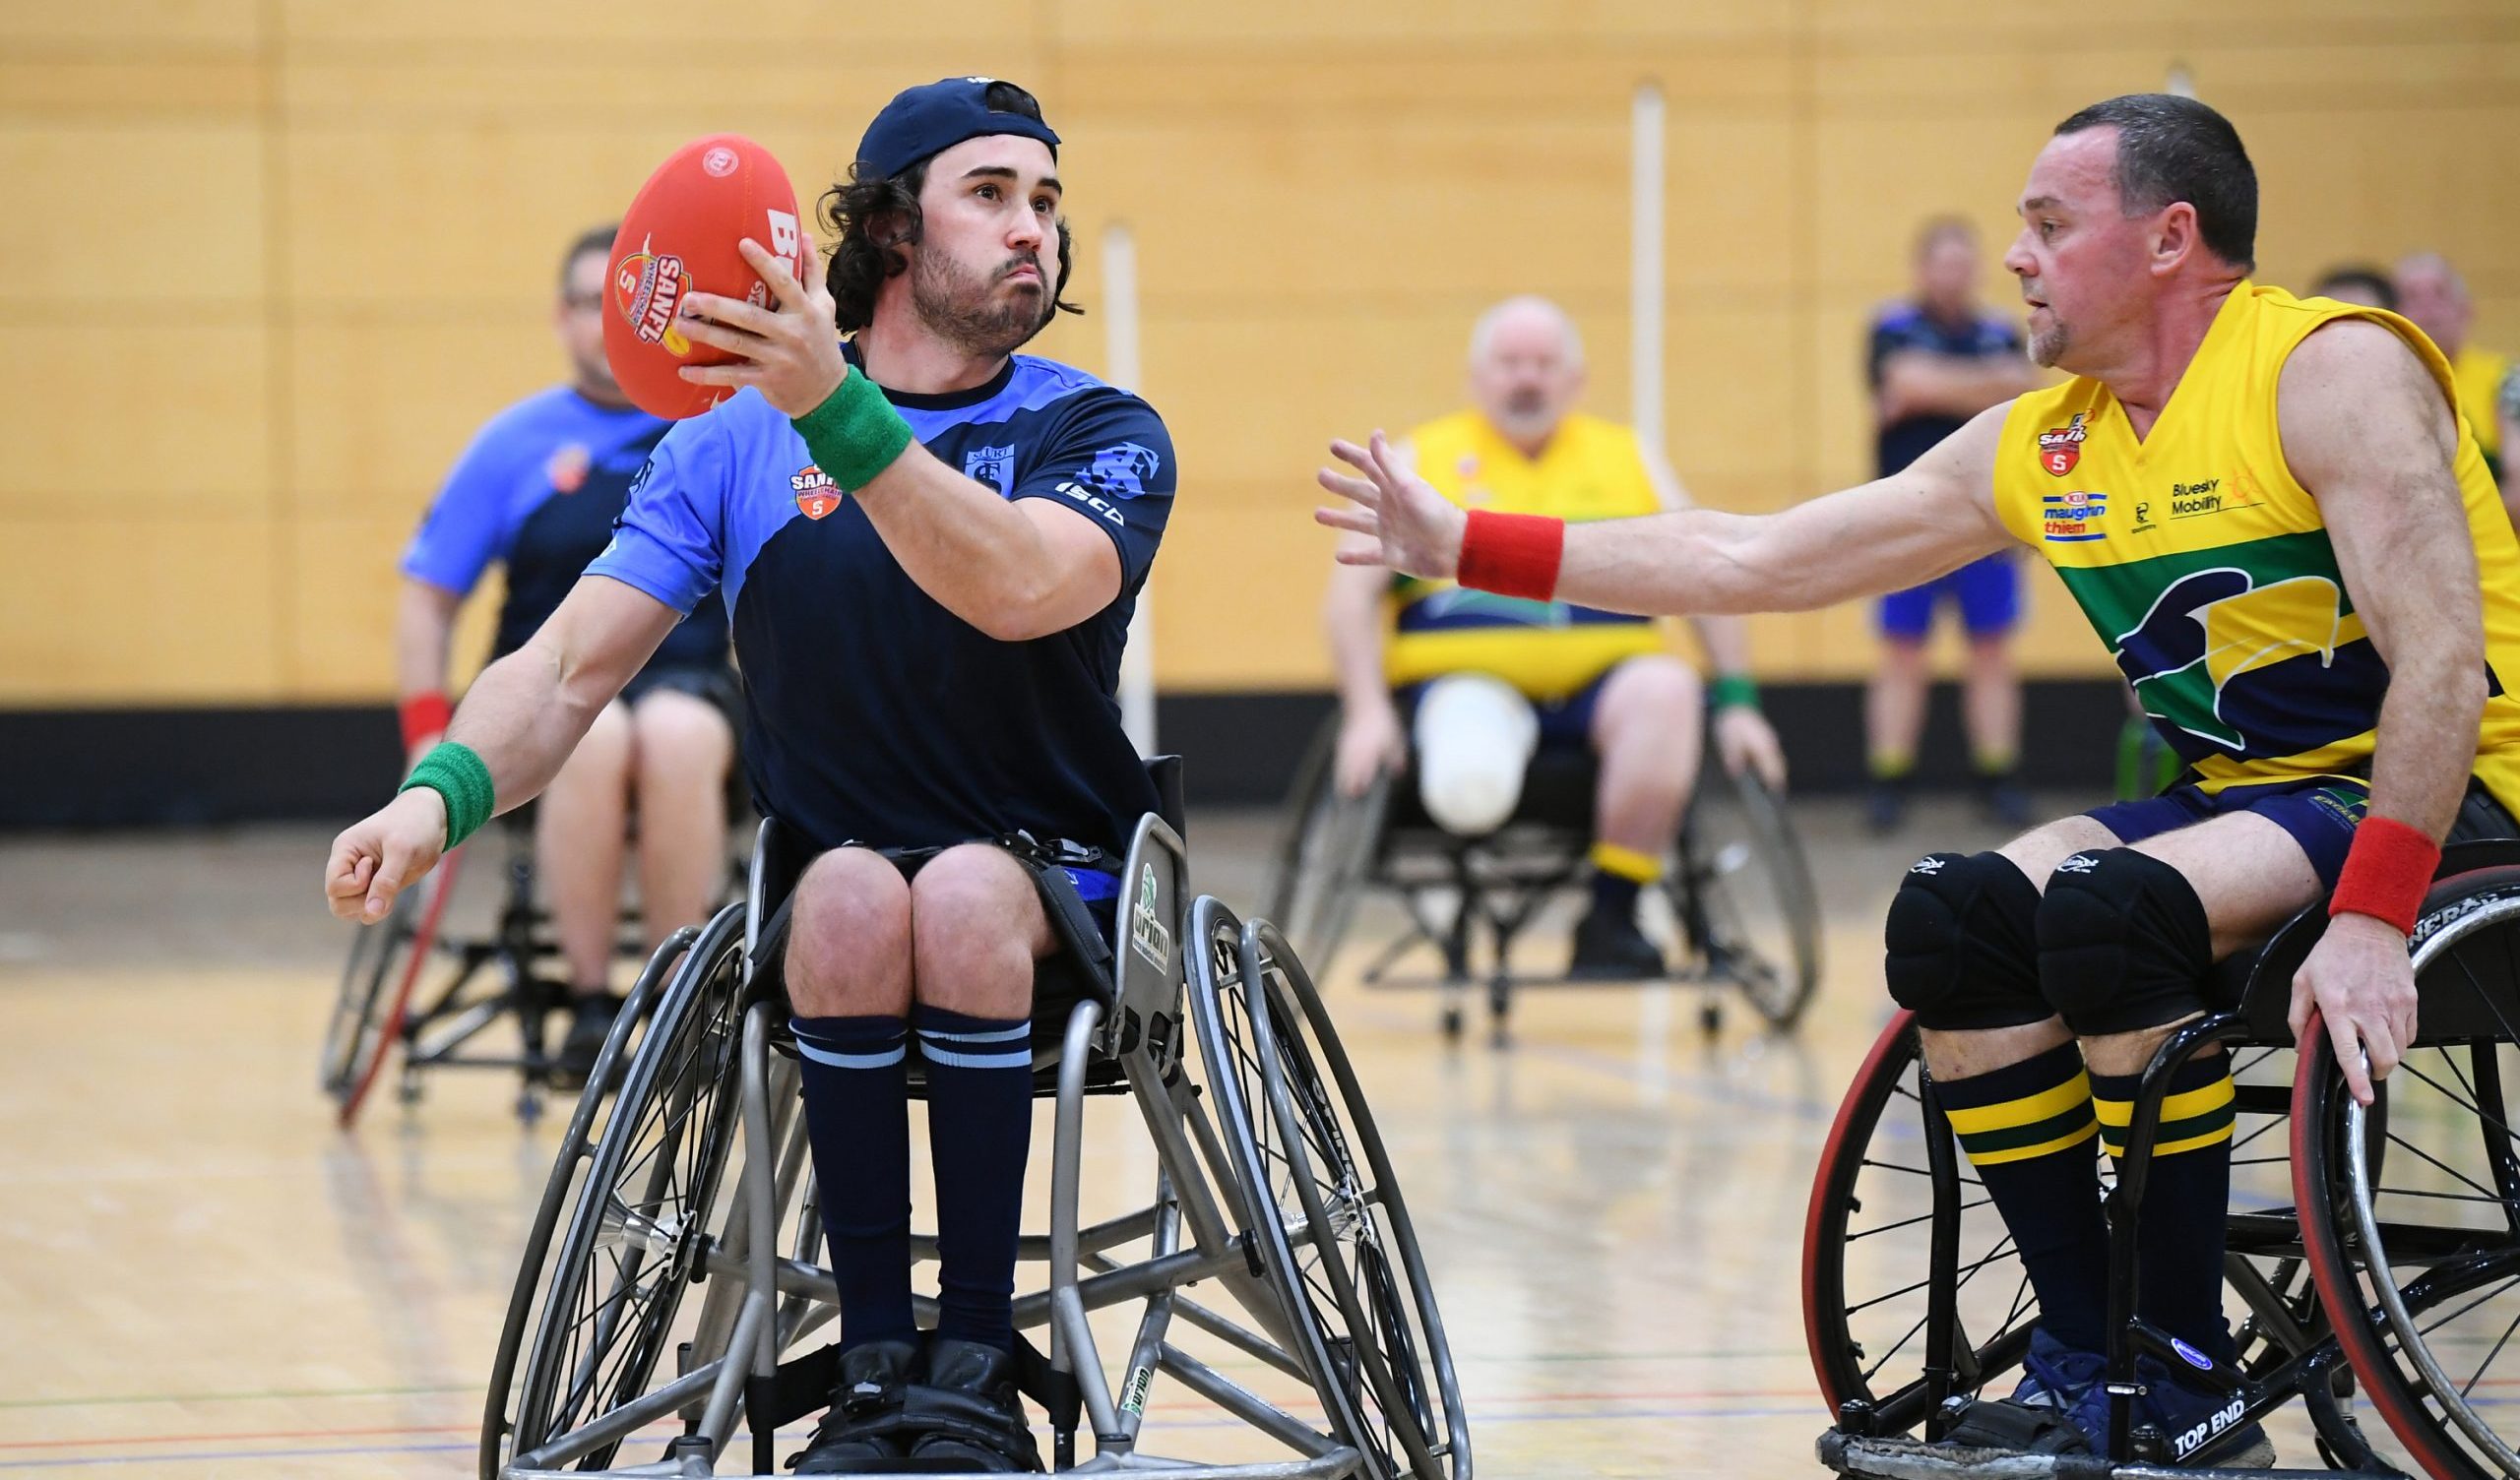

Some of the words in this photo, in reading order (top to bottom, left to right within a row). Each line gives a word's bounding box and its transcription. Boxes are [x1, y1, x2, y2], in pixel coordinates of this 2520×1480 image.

[638, 256, 681, 343] SANFL
[2172, 496, 2222, 515] Mobility
[2173, 479, 2219, 497] Bluesky
[2045, 522, 2085, 533] thiem
[1134, 910, 1168, 959] orion
[1132, 1368, 1150, 1407] orion
[2174, 1423, 2207, 1455] TOP
[2211, 1400, 2244, 1434] END
